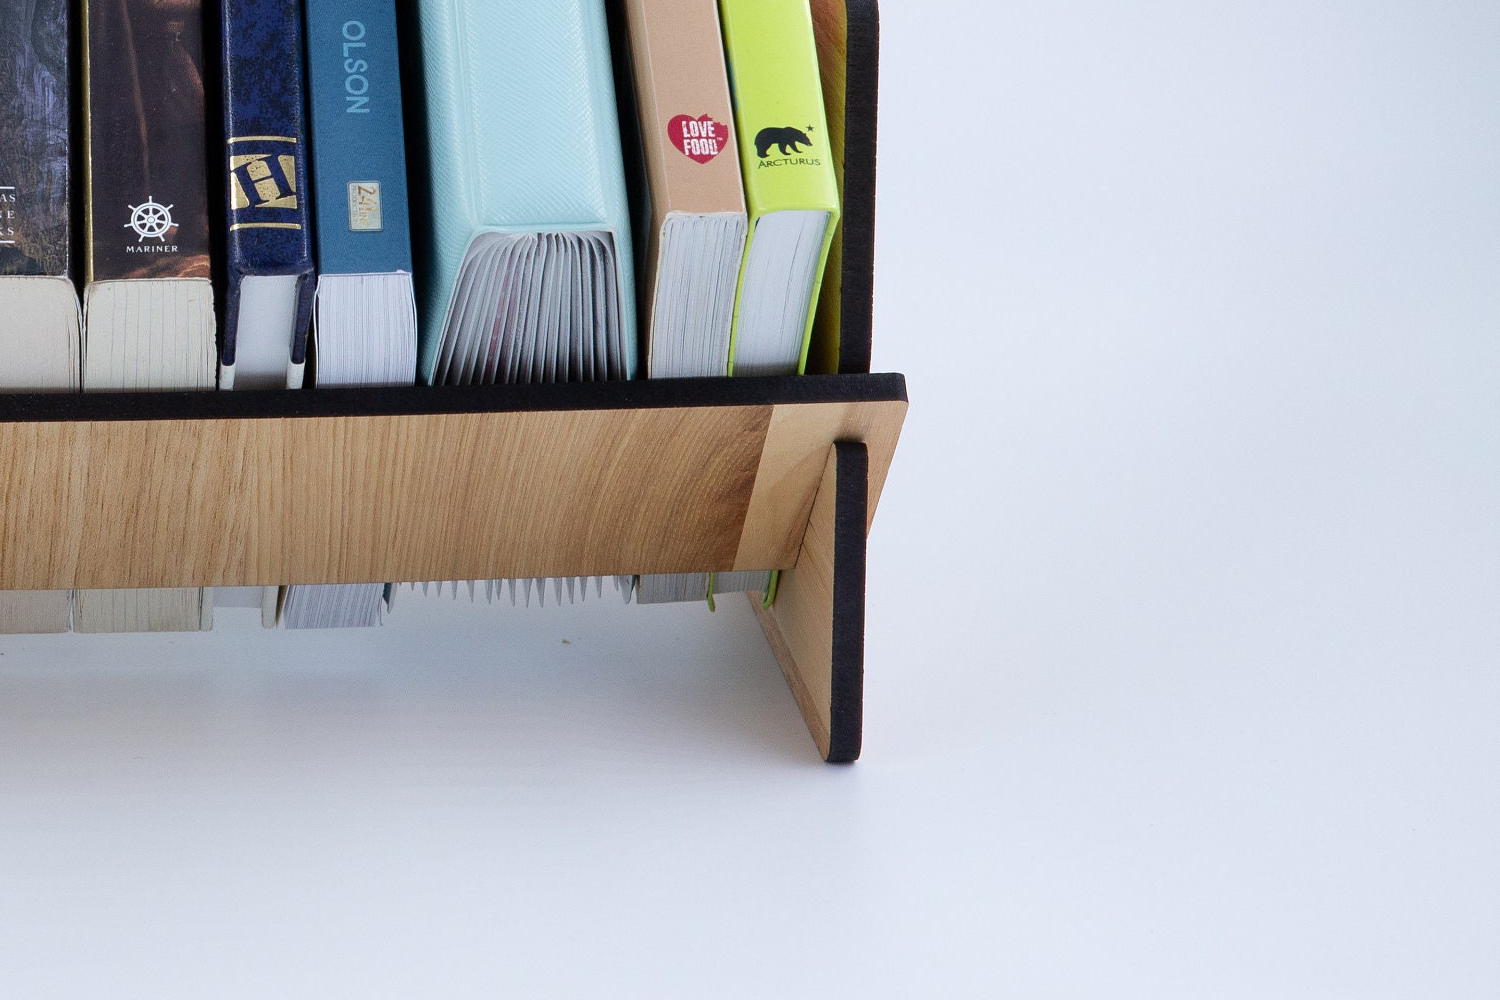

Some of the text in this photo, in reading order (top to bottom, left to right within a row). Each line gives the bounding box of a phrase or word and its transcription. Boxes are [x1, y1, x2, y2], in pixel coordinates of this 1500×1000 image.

[342, 20, 371, 114] OLSON
[681, 120, 716, 138] LOVE
[757, 158, 821, 169] ARCTURUS
[126, 245, 178, 253] MARINER
